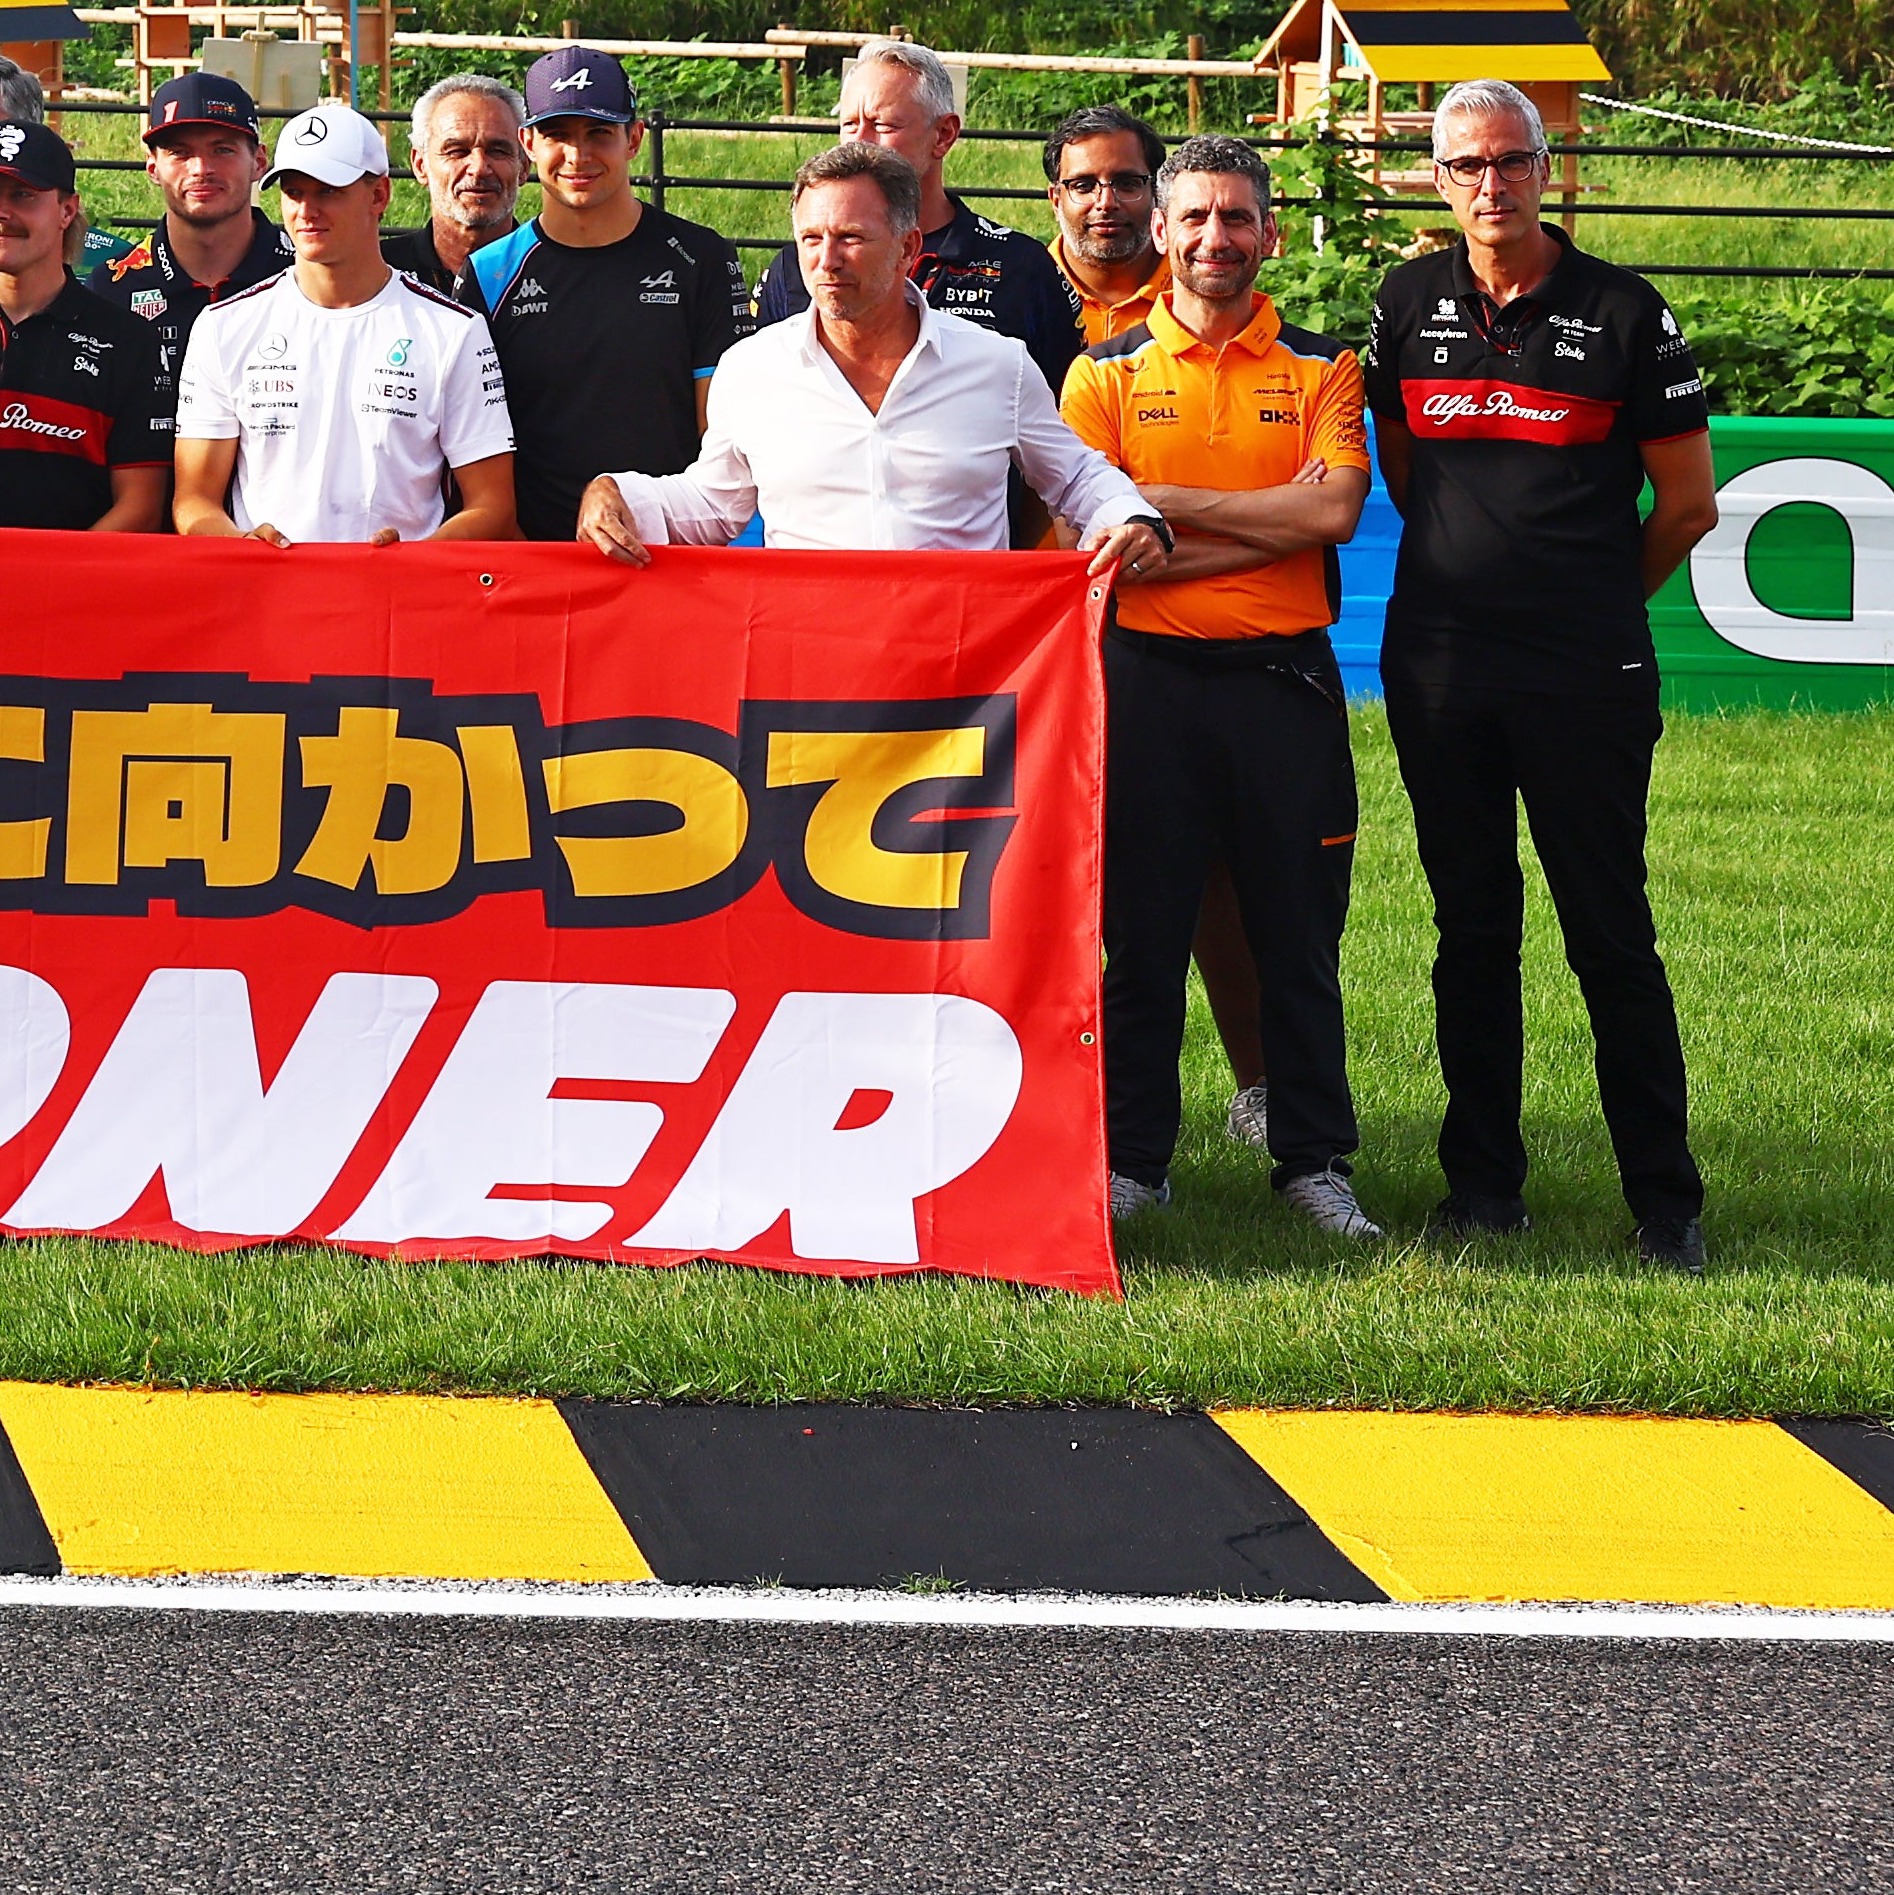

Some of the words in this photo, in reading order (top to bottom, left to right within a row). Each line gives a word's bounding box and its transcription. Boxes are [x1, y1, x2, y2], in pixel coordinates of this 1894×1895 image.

[164, 100, 179, 123] 1
[156, 242, 175, 282] zoom
[967, 259, 1002, 269] ACLE
[133, 290, 162, 305] TAG
[649, 293, 678, 304] Castrol
[945, 287, 993, 303] BYBIT
[938, 306, 996, 318] HONDA
[1571, 318, 1603, 333] Romeo
[1554, 342, 1586, 361] Stake
[374, 368, 415, 378] PETRONAS
[264, 380, 295, 393] UBS
[367, 382, 418, 402] INEOS
[370, 405, 418, 419] TeamViewer
[1138, 407, 1179, 422] DELL
[1423, 394, 1485, 425] Alfa
[1482, 391, 1569, 424] Romeo
